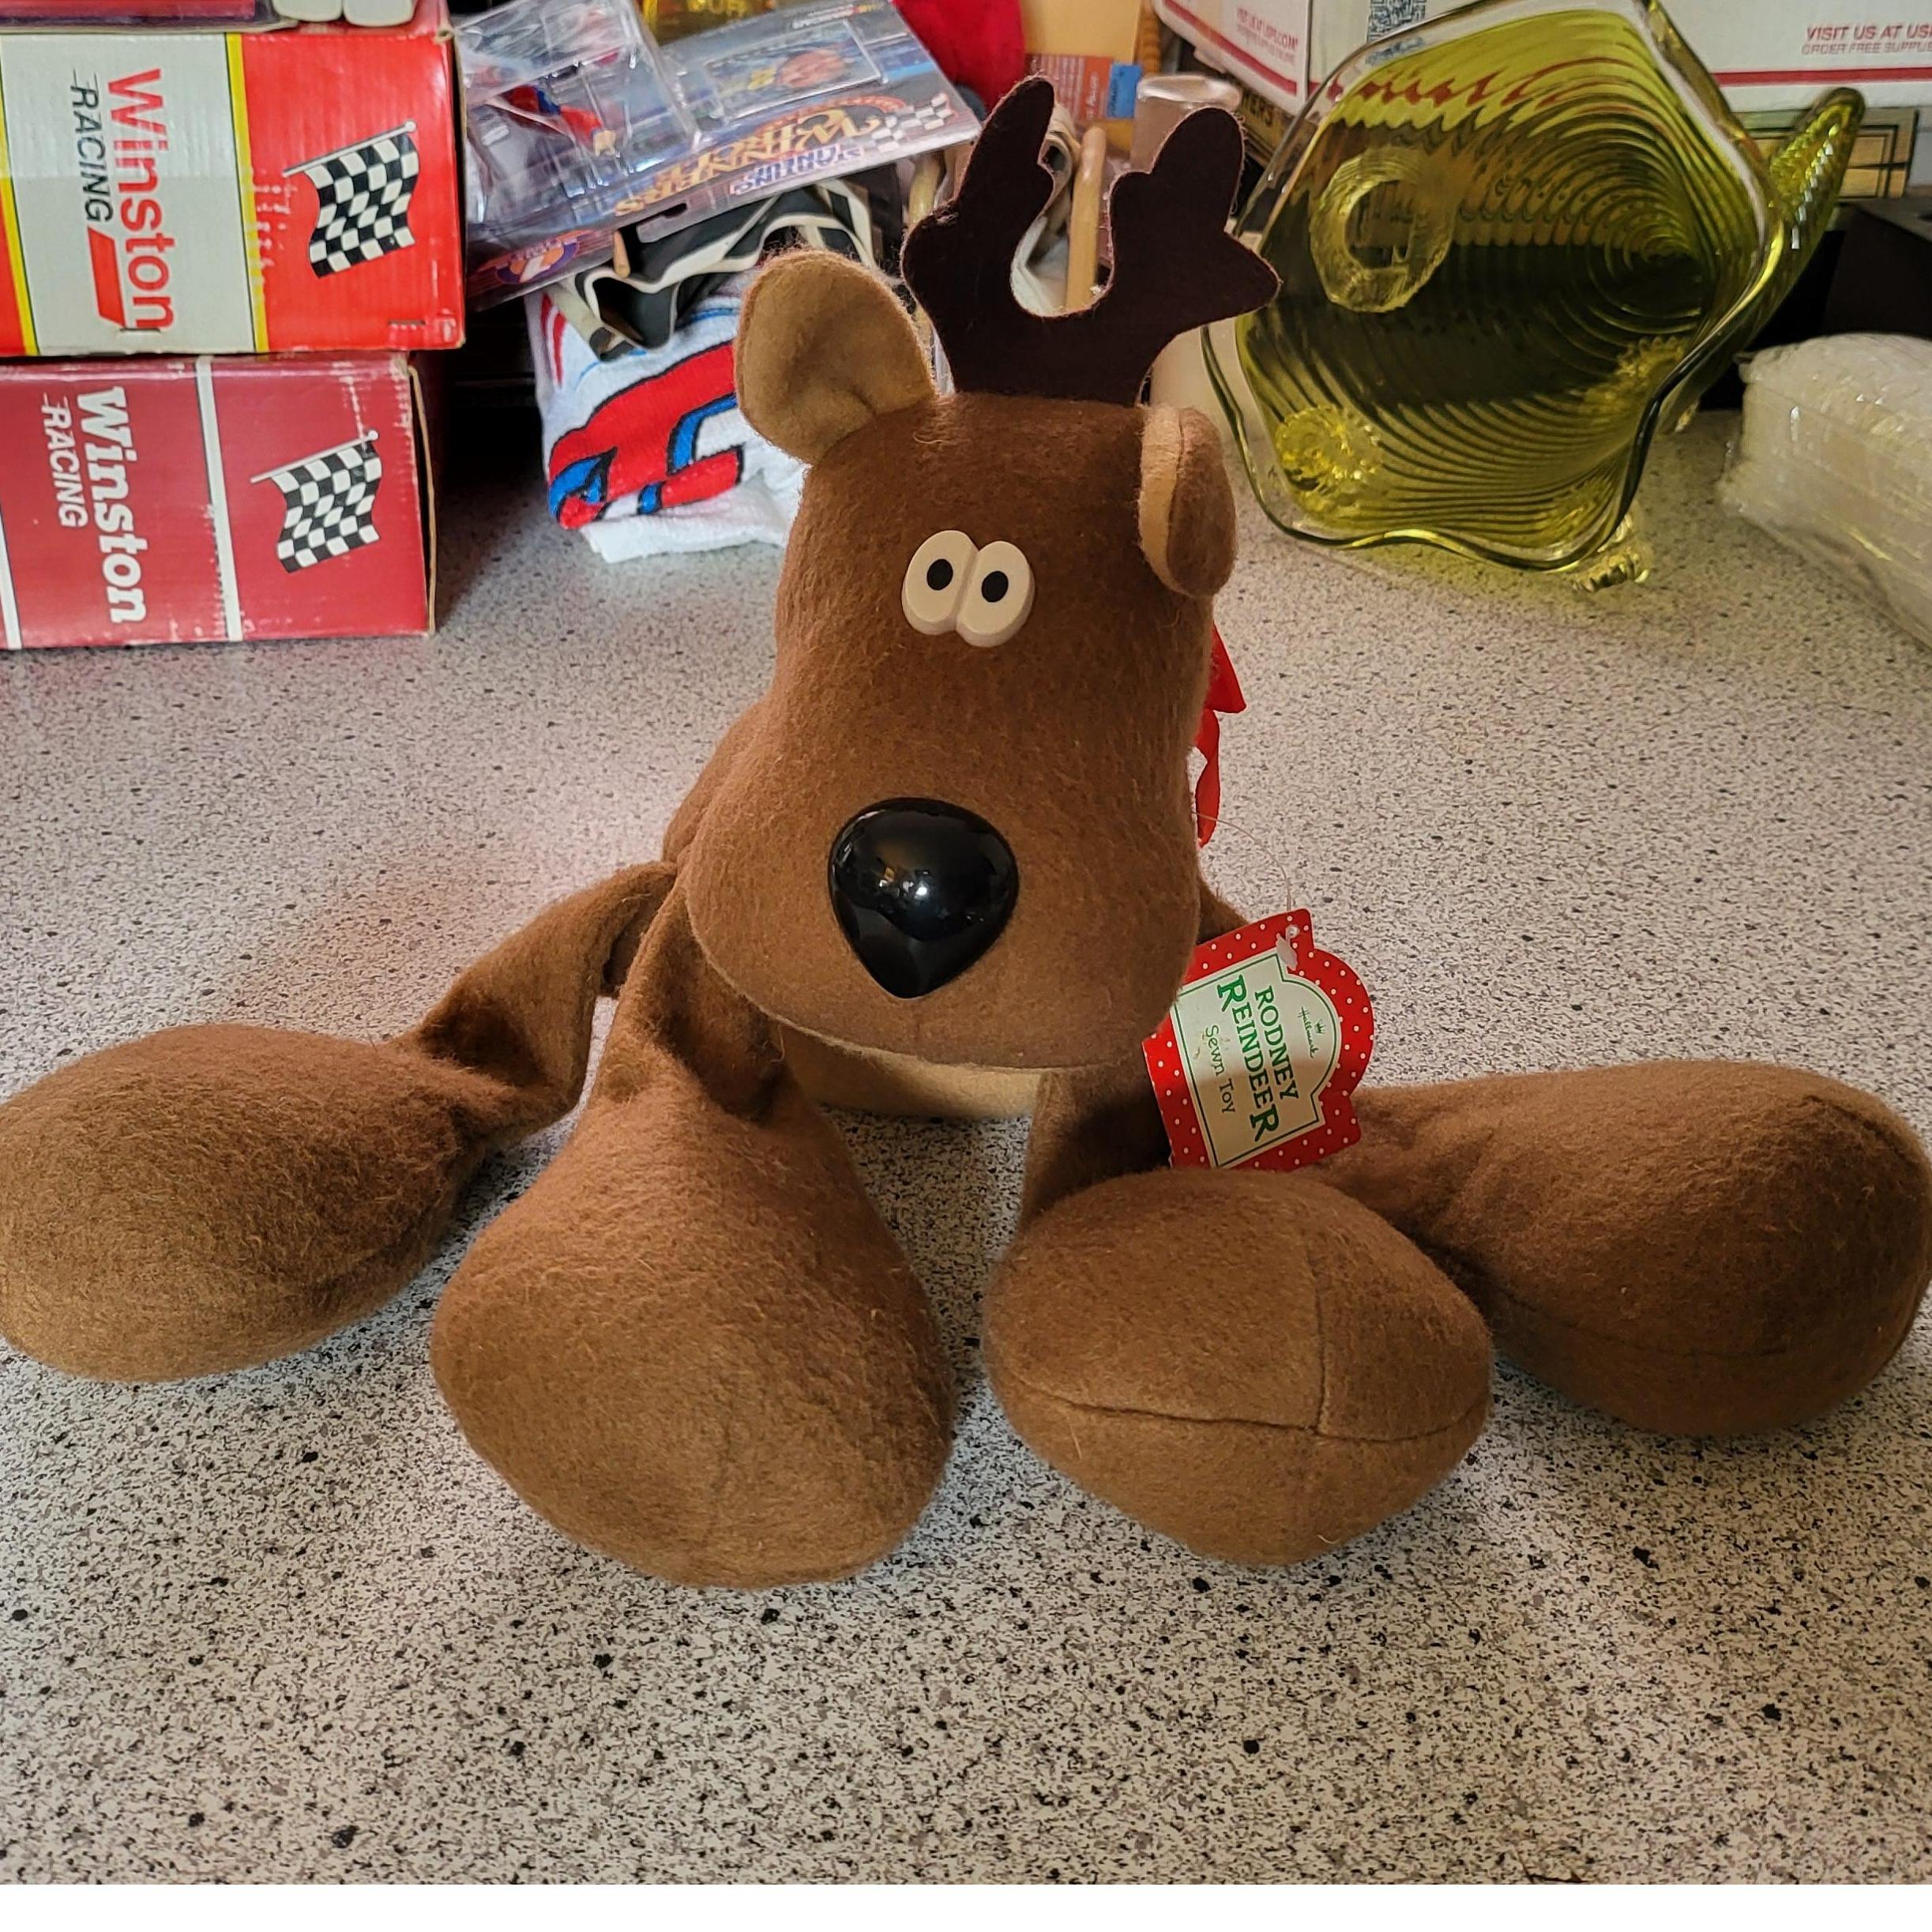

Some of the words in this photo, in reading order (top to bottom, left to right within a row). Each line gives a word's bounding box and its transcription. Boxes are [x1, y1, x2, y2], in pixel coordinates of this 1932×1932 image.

[1802, 43, 1846, 55] ORDER
[1848, 42, 1881, 54] FREE
[1806, 26, 1849, 41] VISIT
[1854, 24, 1877, 39] US
[1880, 24, 1903, 39] AT
[70, 70, 114, 224] RACING
[107, 68, 177, 330] Winston
[41, 393, 88, 528] RACING
[77, 385, 148, 624] Winston
[1205, 1024, 1225, 1077] Sewn
[1219, 1077, 1236, 1114] Toy
[1216, 974, 1280, 1142] REINDEER
[1254, 986, 1299, 1100] RODNEY
[1298, 1006, 1320, 1059] Hallmark
